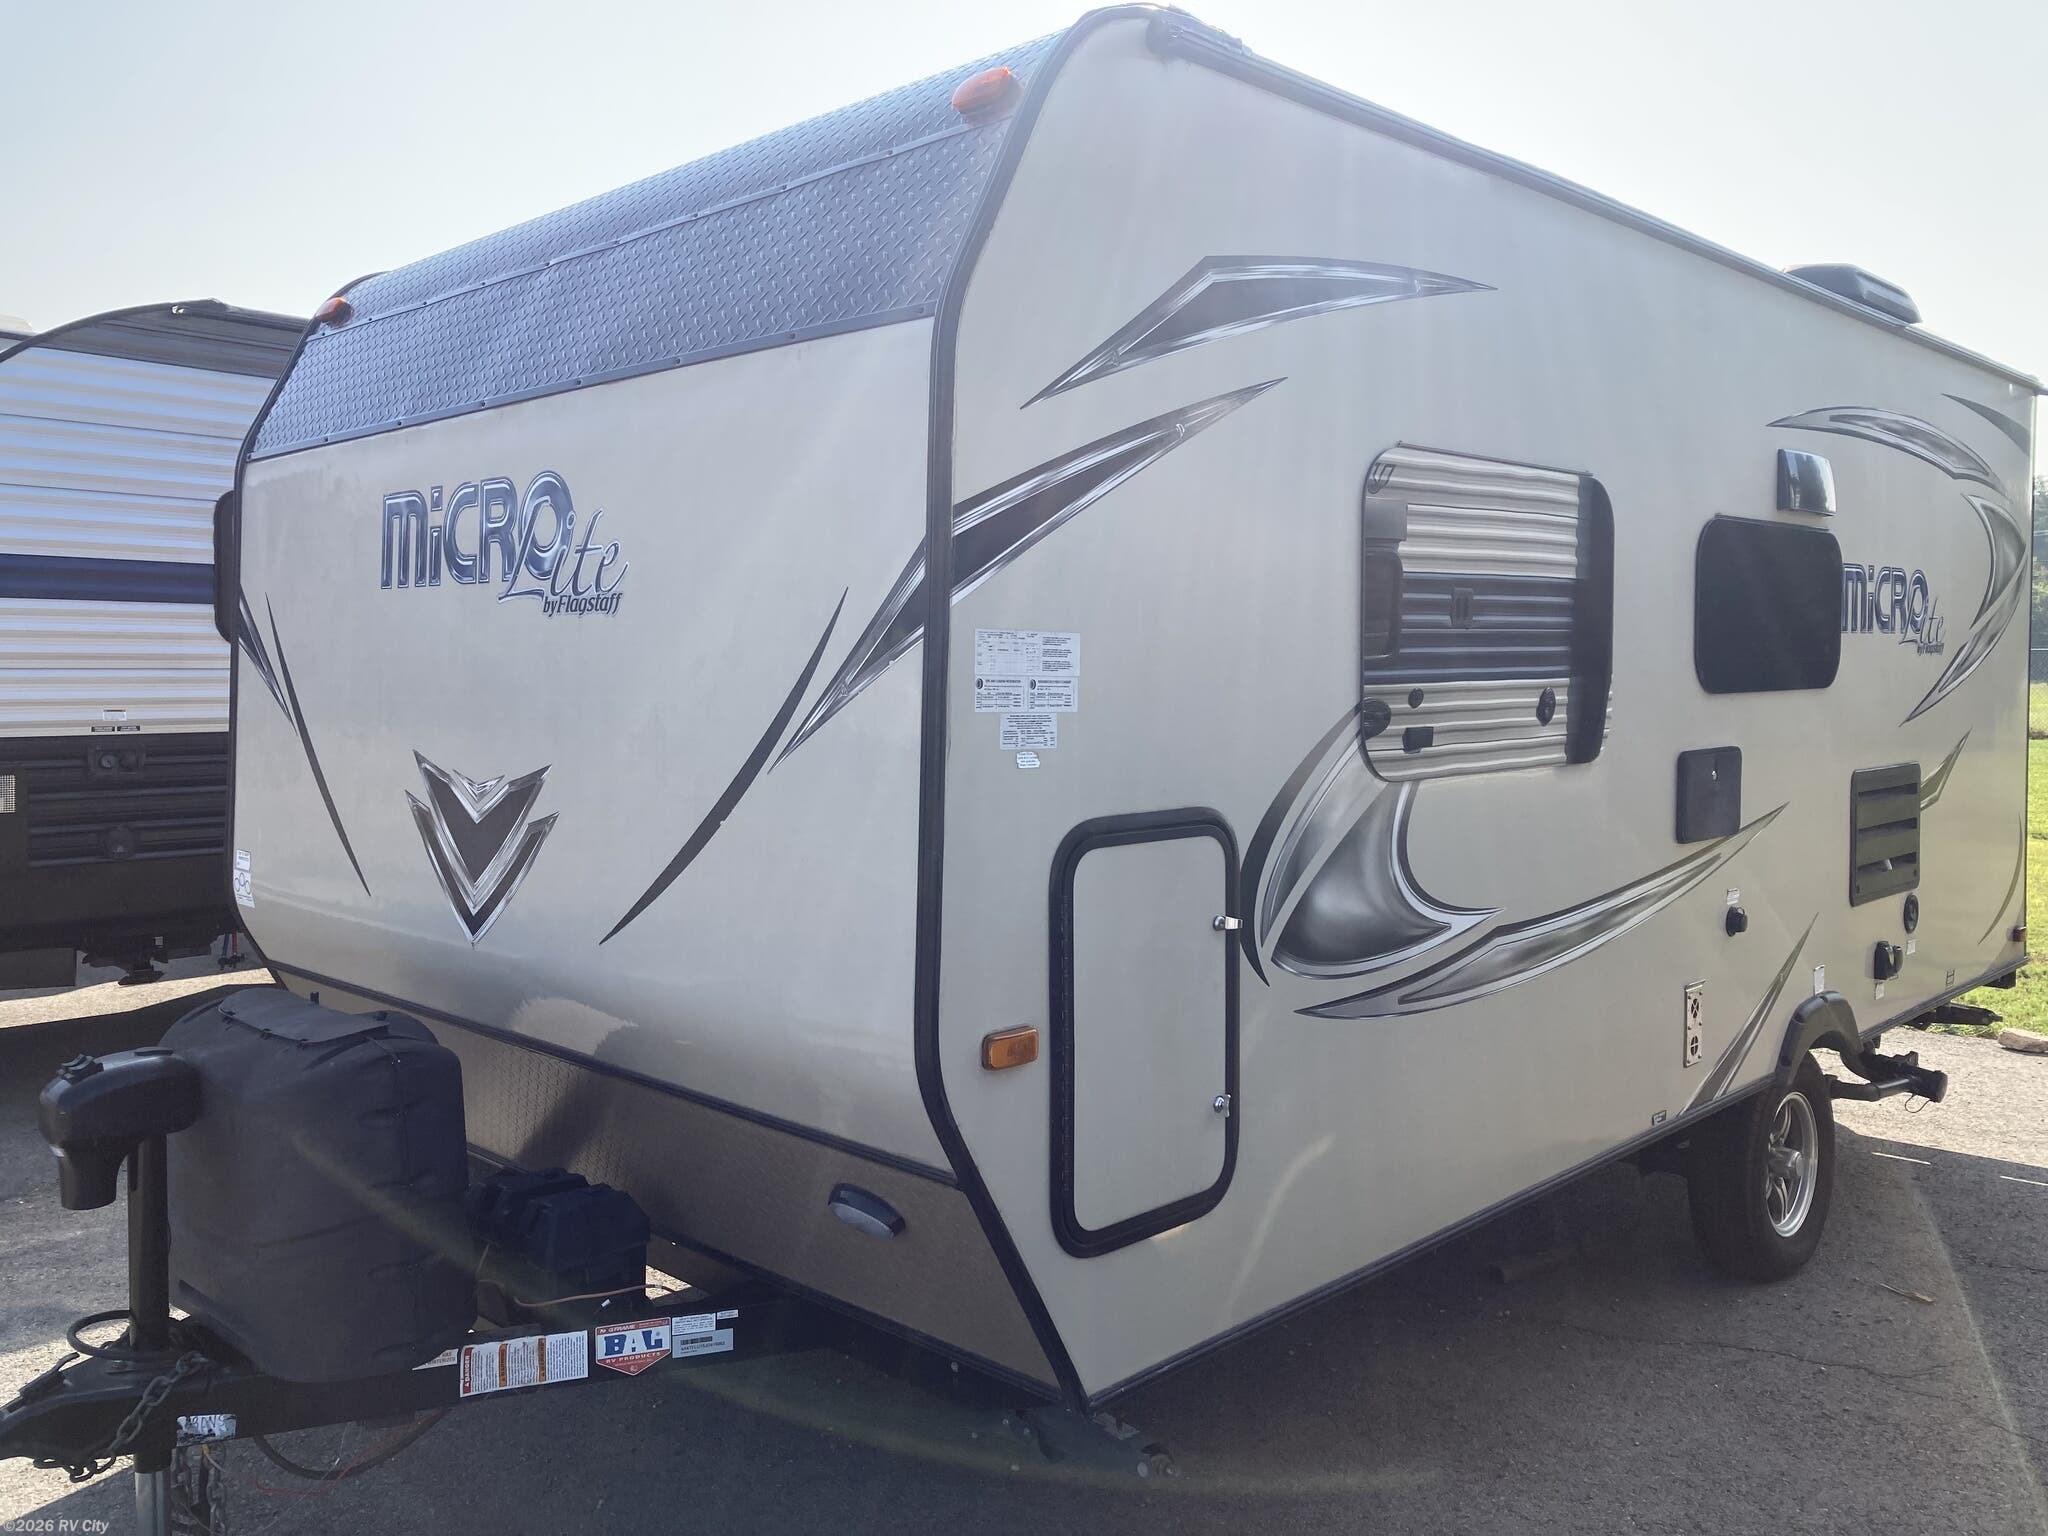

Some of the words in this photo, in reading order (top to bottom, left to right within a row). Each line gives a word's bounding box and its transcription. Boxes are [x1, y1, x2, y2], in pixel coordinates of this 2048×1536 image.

[496, 496, 629, 604] Lite
[557, 592, 623, 616] Flagstaff
[604, 1330, 663, 1356] BAL
[618, 1351, 661, 1362] PRODUCTS
